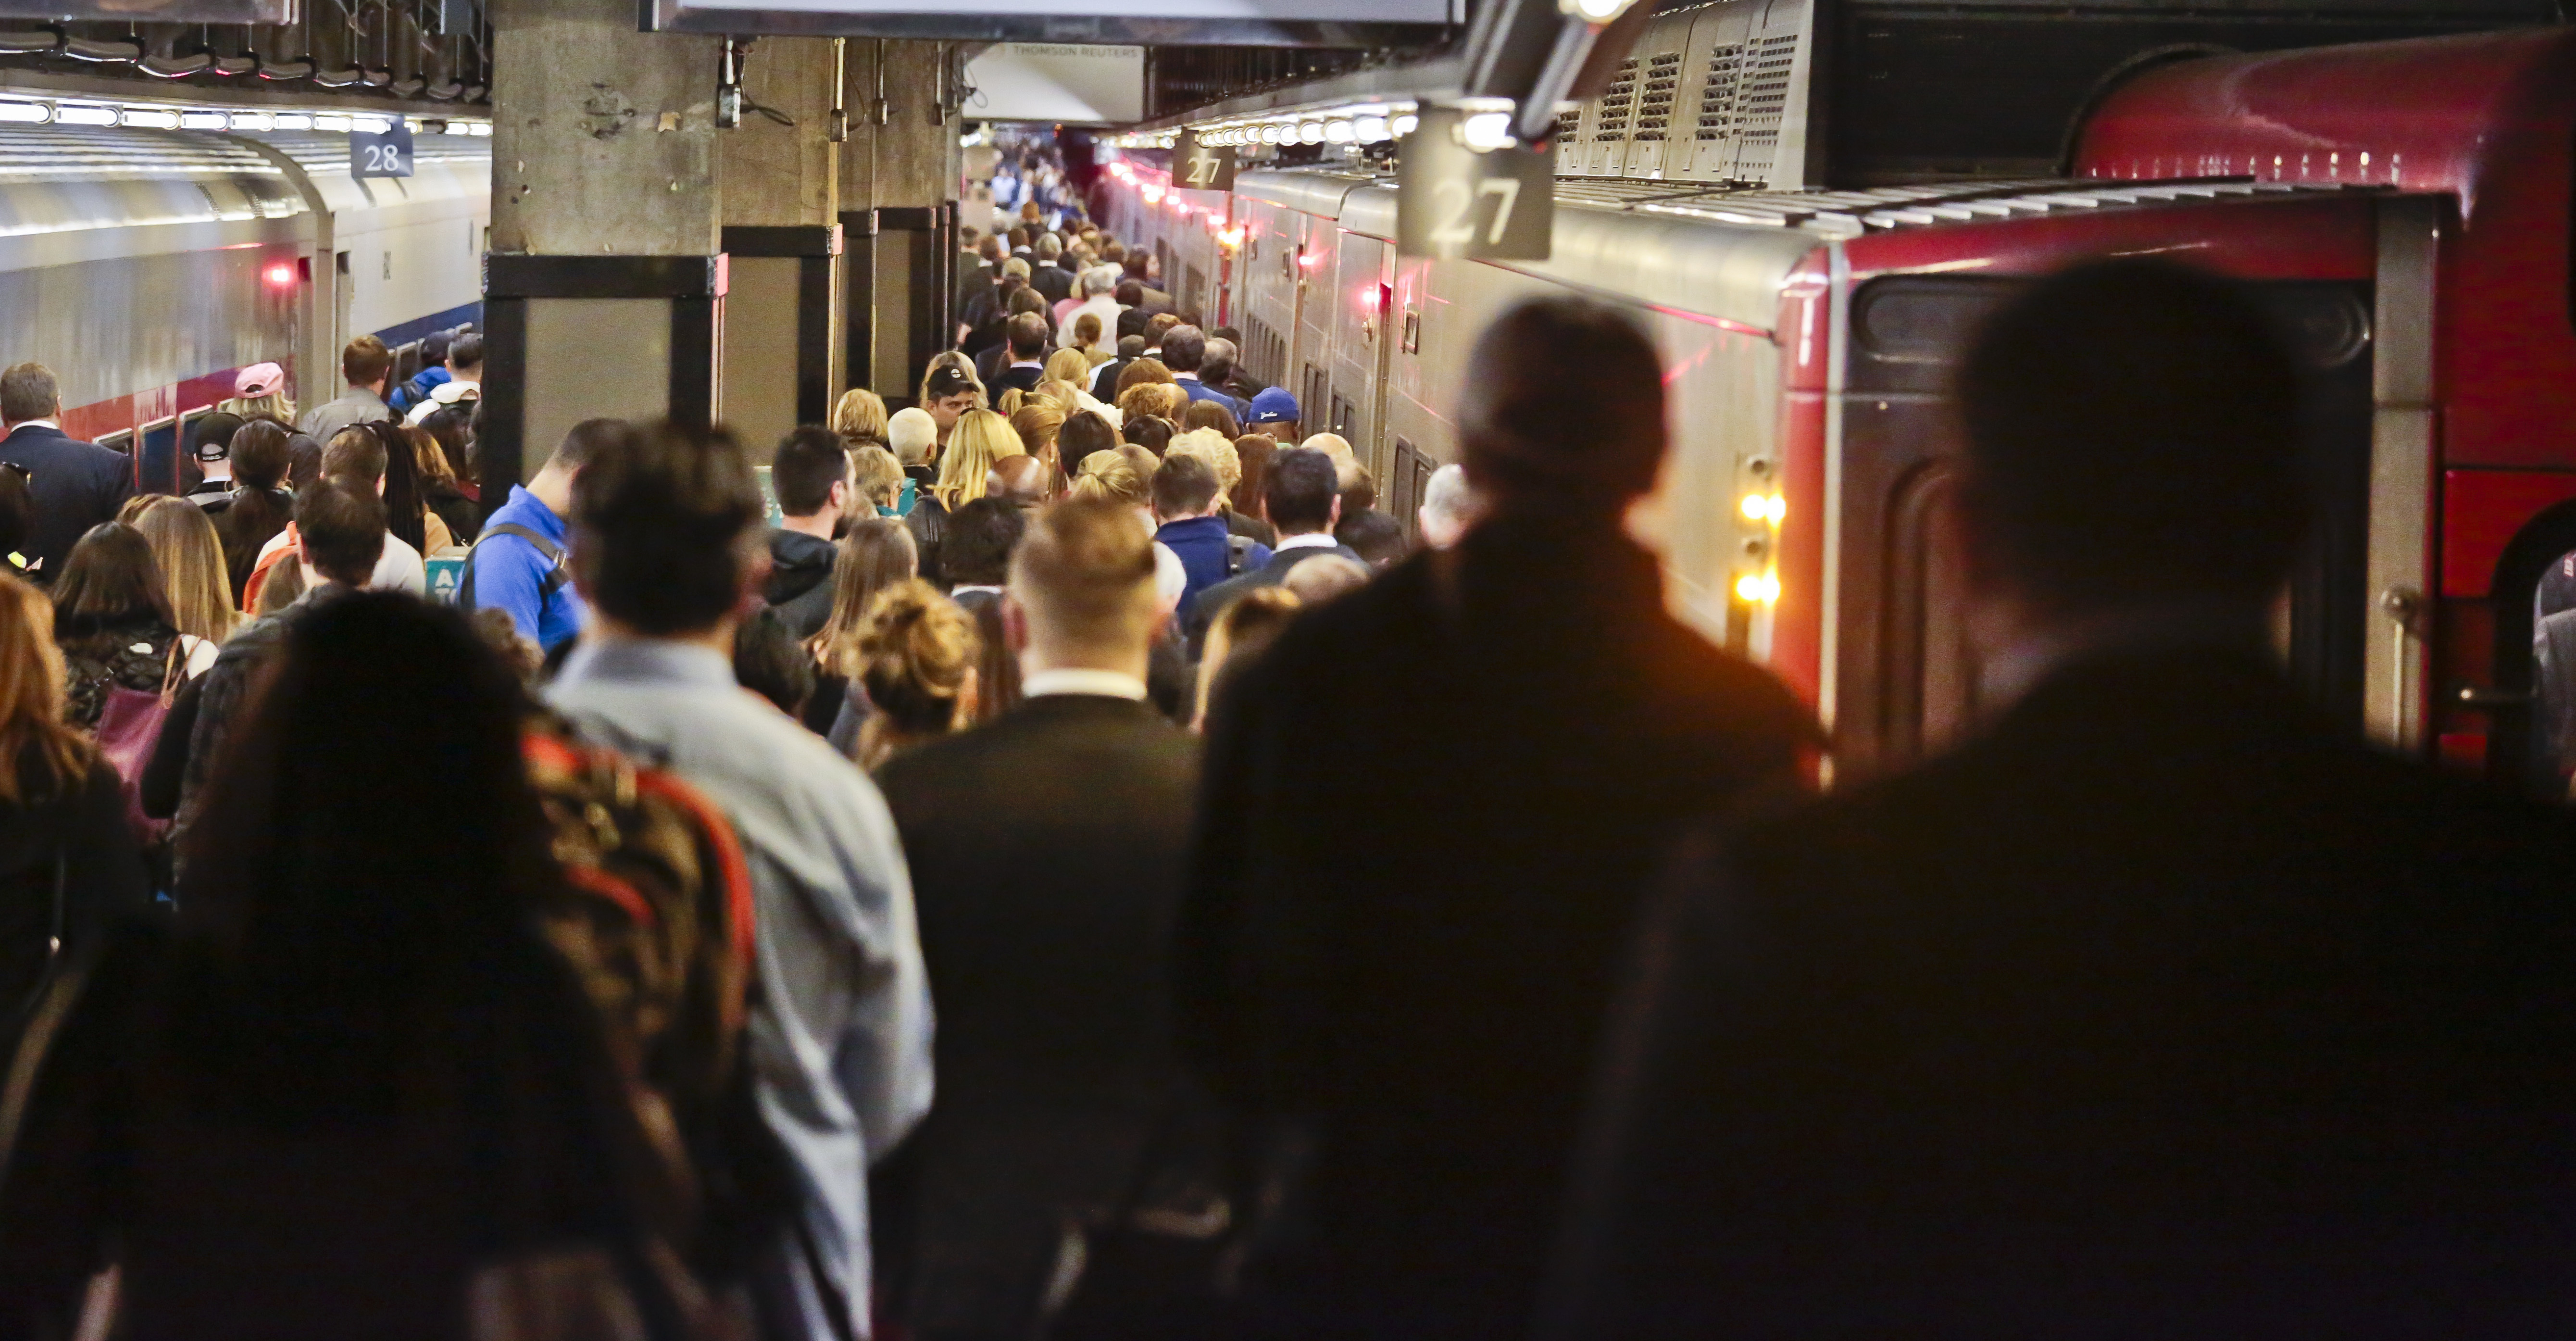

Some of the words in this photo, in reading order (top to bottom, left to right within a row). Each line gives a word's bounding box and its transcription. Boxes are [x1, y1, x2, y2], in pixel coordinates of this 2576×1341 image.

[1013, 45, 1077, 56] THOMSON
[1081, 46, 1138, 58] REUTERS
[365, 144, 399, 171] 28
[1186, 157, 1221, 184] 27
[1429, 177, 1521, 244] 27
